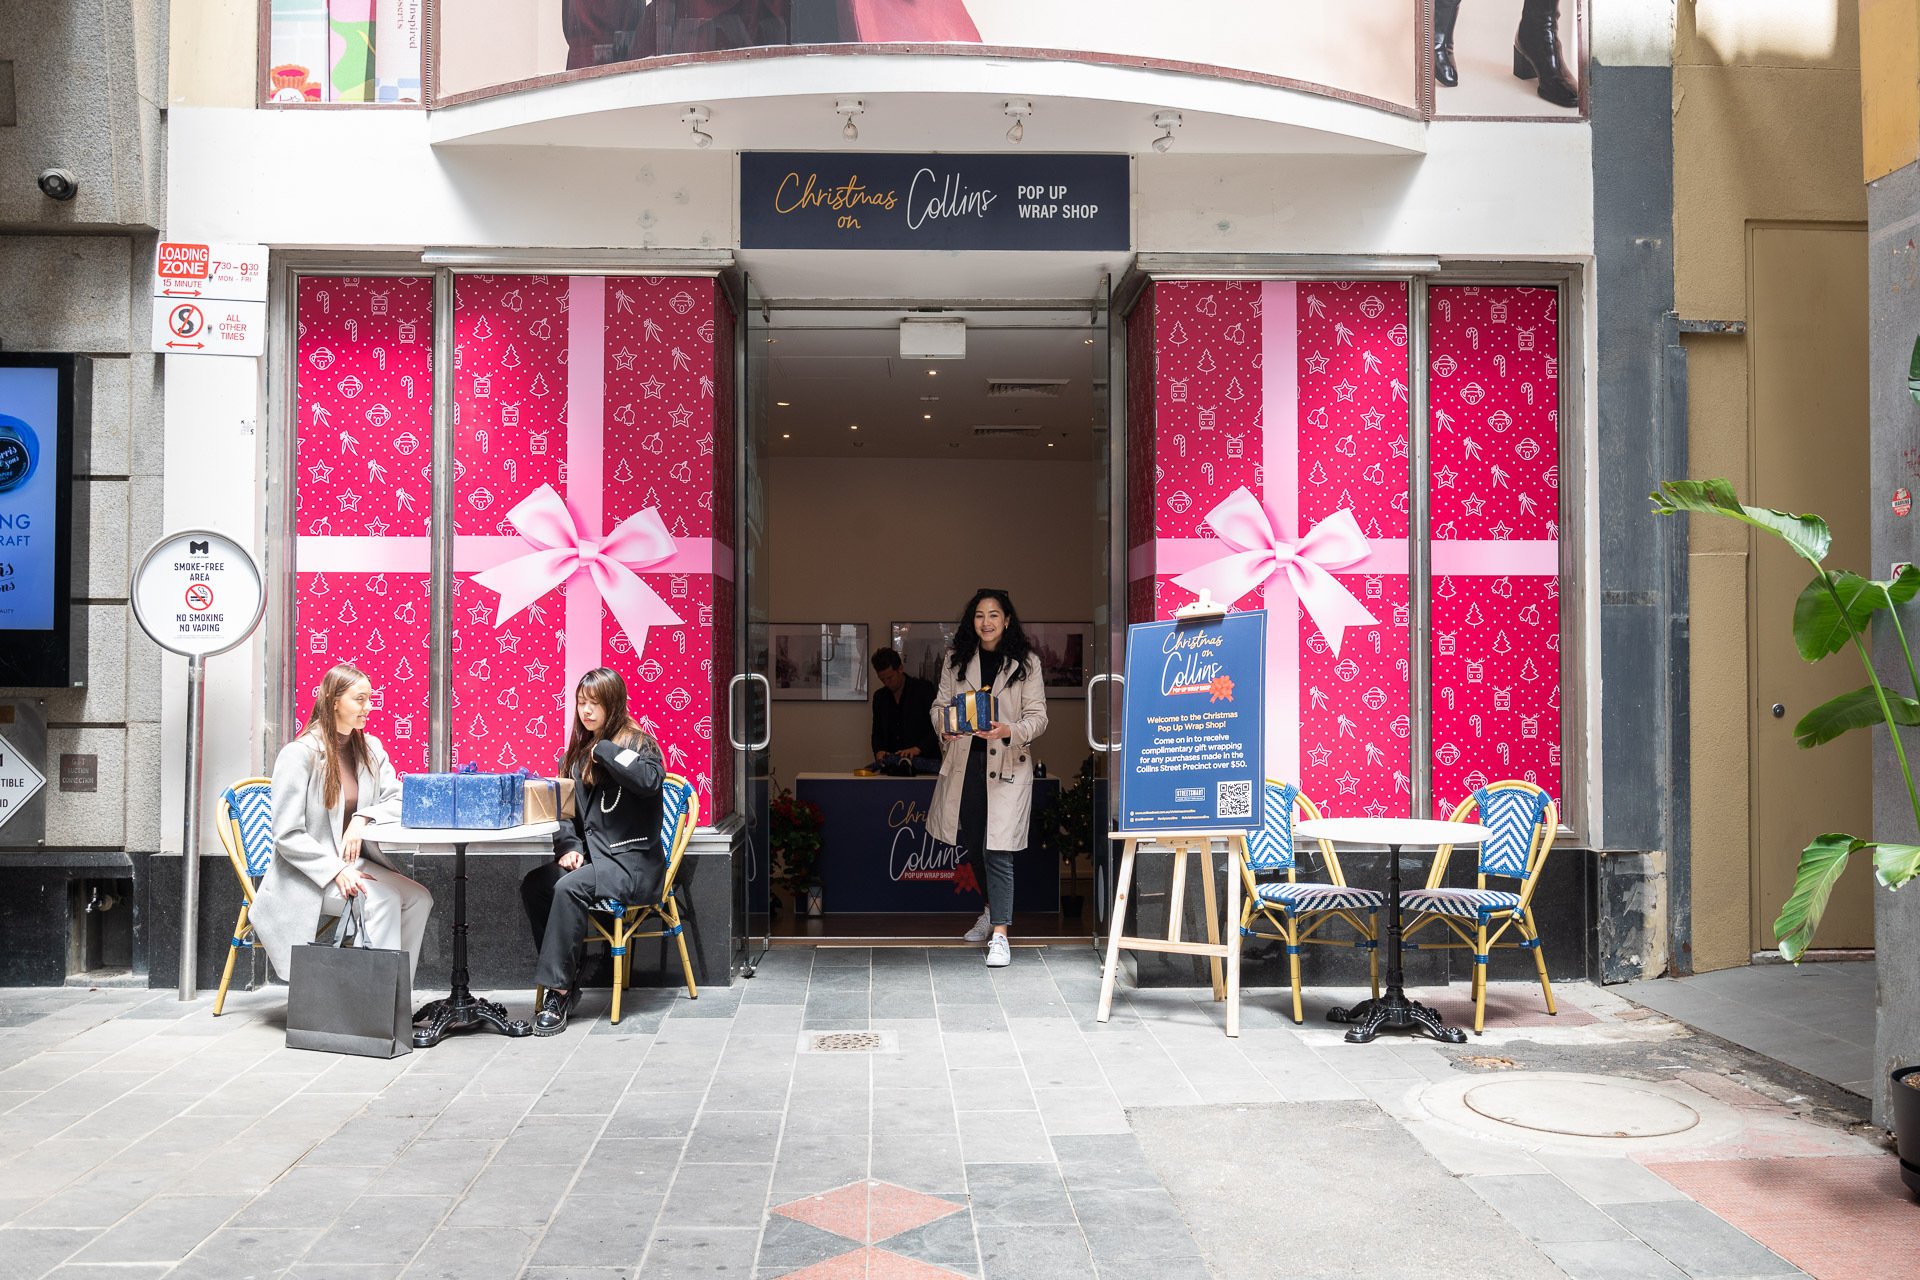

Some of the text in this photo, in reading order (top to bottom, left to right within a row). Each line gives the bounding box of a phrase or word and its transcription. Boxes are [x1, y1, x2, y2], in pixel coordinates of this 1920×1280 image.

[775, 168, 997, 230] Christmas on Collins
[1018, 186, 1067, 200] POP UP
[1018, 205, 1098, 218] WRAP SHOP
[160, 247, 208, 261] LOADING
[162, 261, 204, 275] ZONE
[219, 323, 246, 331] OTHER
[221, 332, 245, 340] TIMES
[1163, 630, 1223, 654] Christmas
[1162, 652, 1222, 696] Collins
[1203, 712, 1238, 720] Christmas
[1206, 721, 1226, 729] Shop!
[1142, 742, 1242, 755] complimentary gift wrapping
[1165, 754, 1200, 763] purchases
[1231, 760, 1247, 768] $50.
[890, 826, 968, 881] Collins
